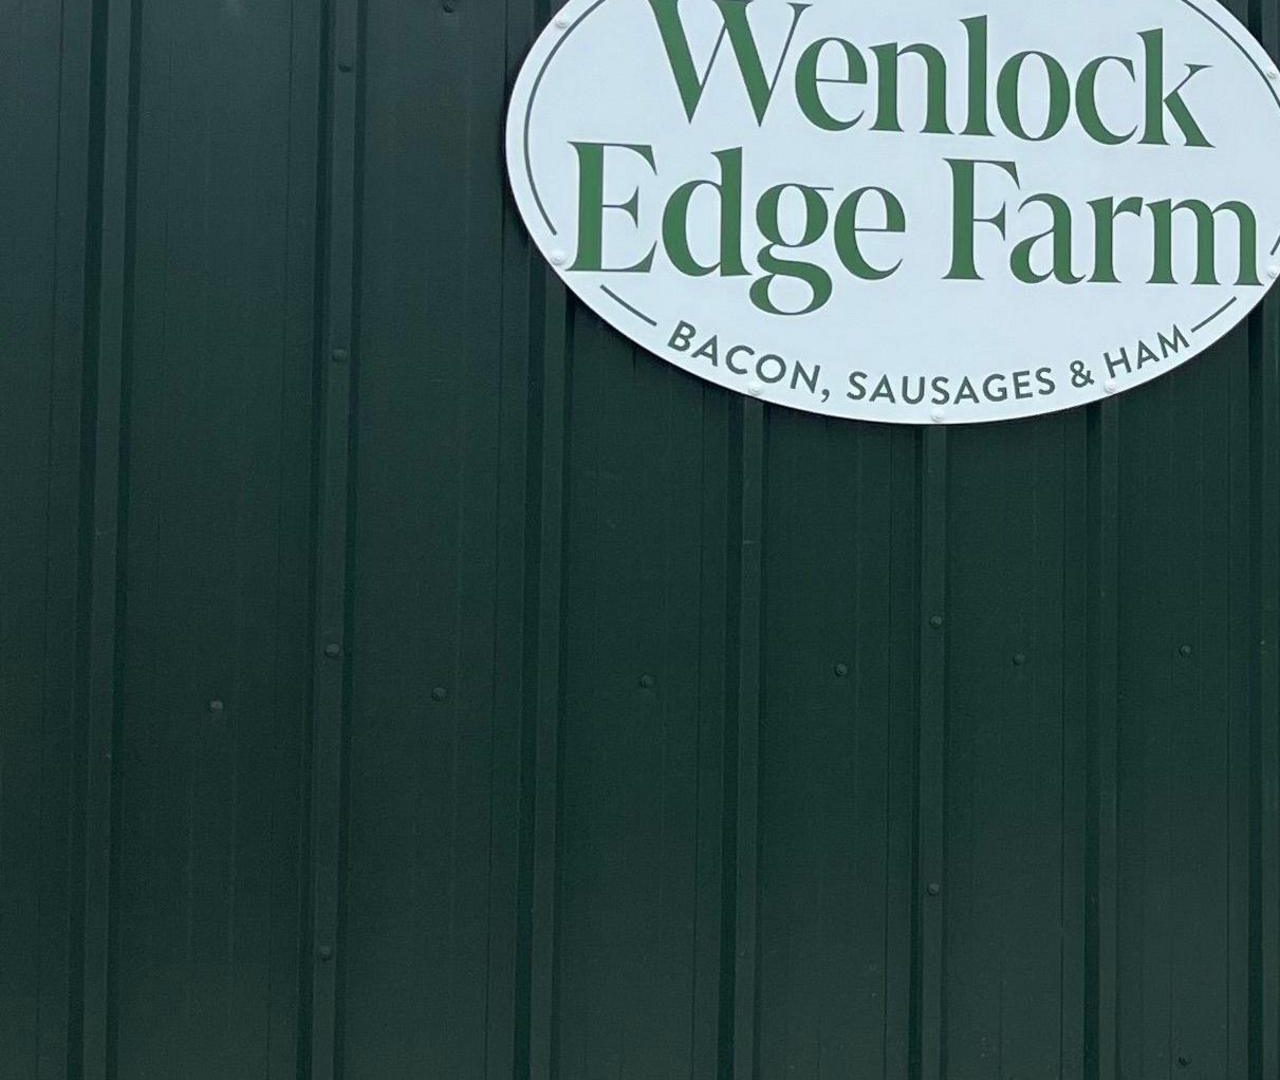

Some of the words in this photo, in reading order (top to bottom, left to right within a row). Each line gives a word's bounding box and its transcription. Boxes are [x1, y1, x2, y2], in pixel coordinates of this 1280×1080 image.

[565, 141, 907, 316] Edge
[942, 157, 1265, 287] Farm
[667, 320, 831, 404] BACON,
[847, 367, 1056, 405] SAUSAGES
[1070, 360, 1095, 389] &
[1104, 324, 1191, 379] HAM
